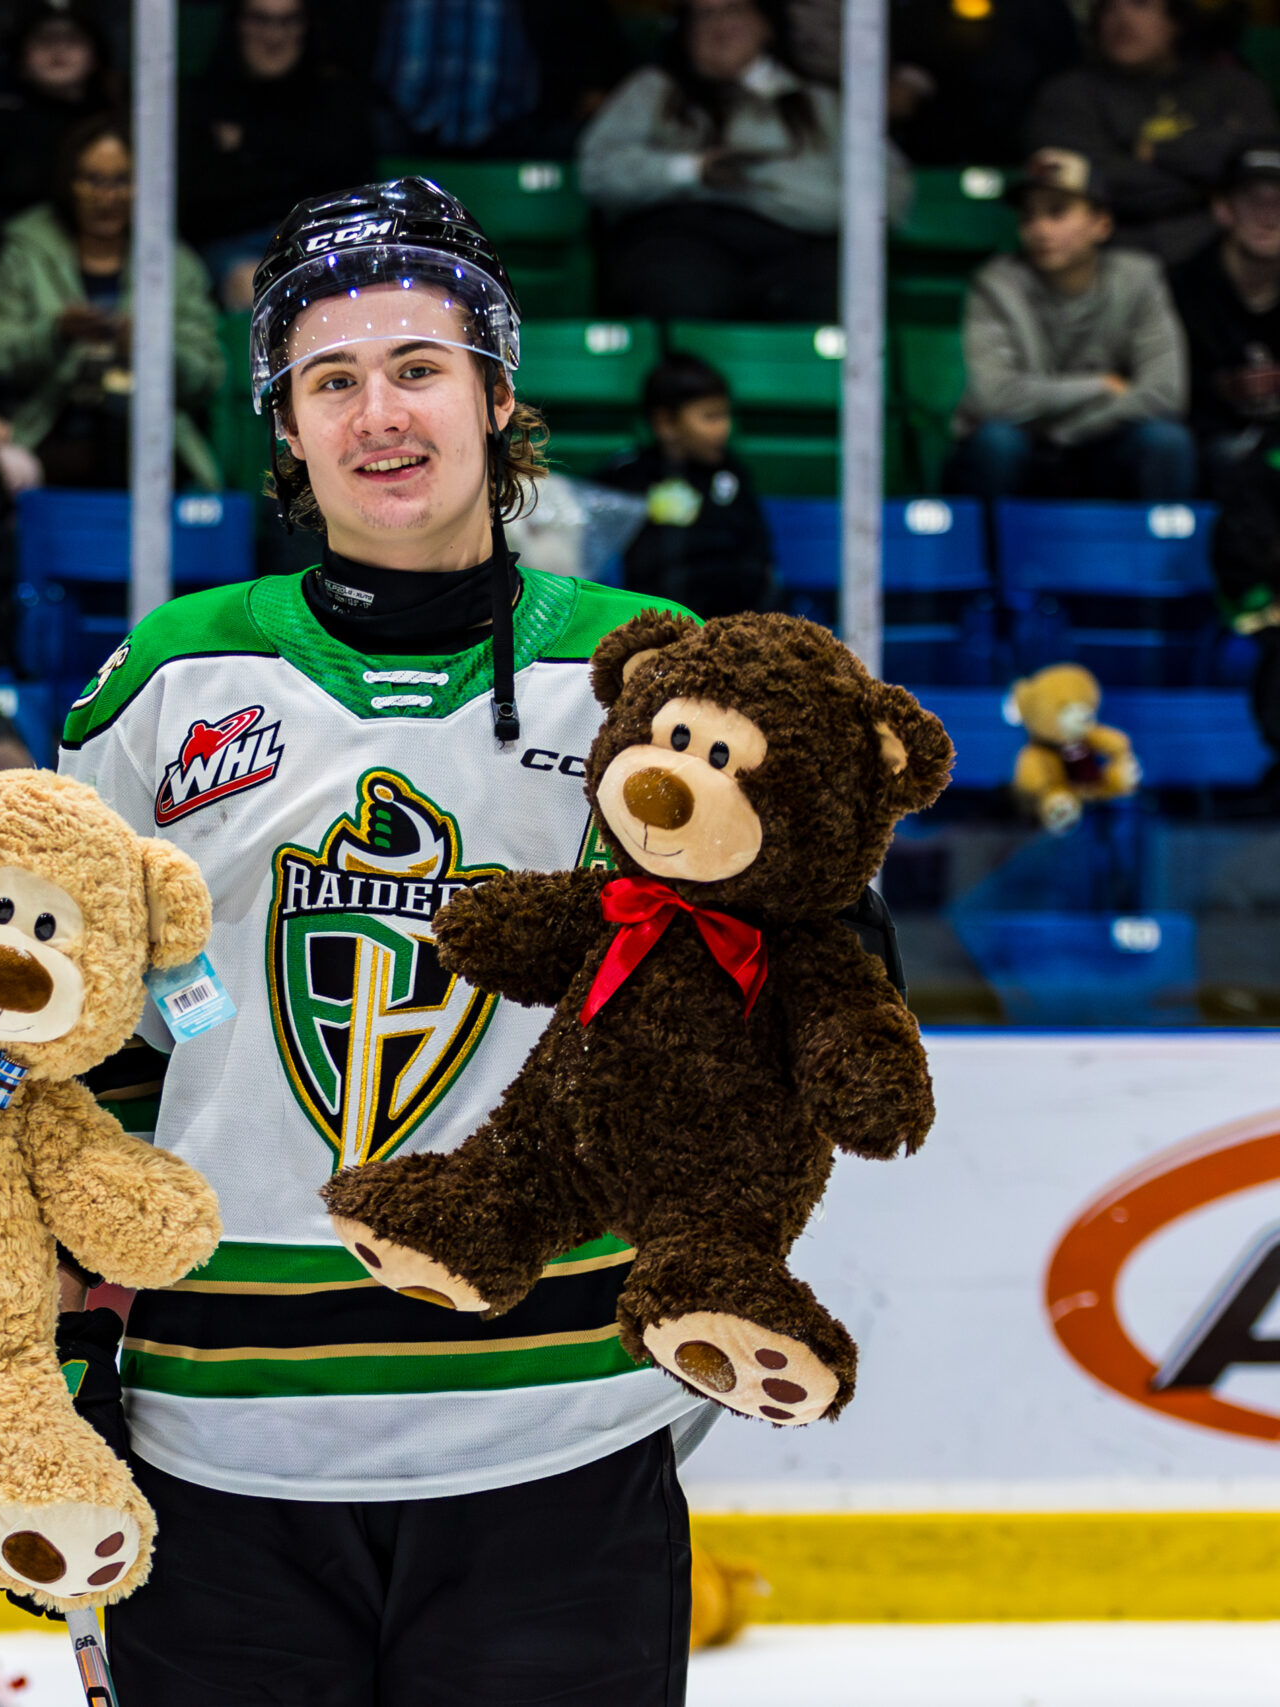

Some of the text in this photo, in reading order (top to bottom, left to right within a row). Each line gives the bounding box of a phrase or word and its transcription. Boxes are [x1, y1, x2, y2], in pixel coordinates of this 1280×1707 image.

[306, 221, 393, 252] CCM
[165, 721, 284, 806] WHL
[520, 748, 587, 778] CC
